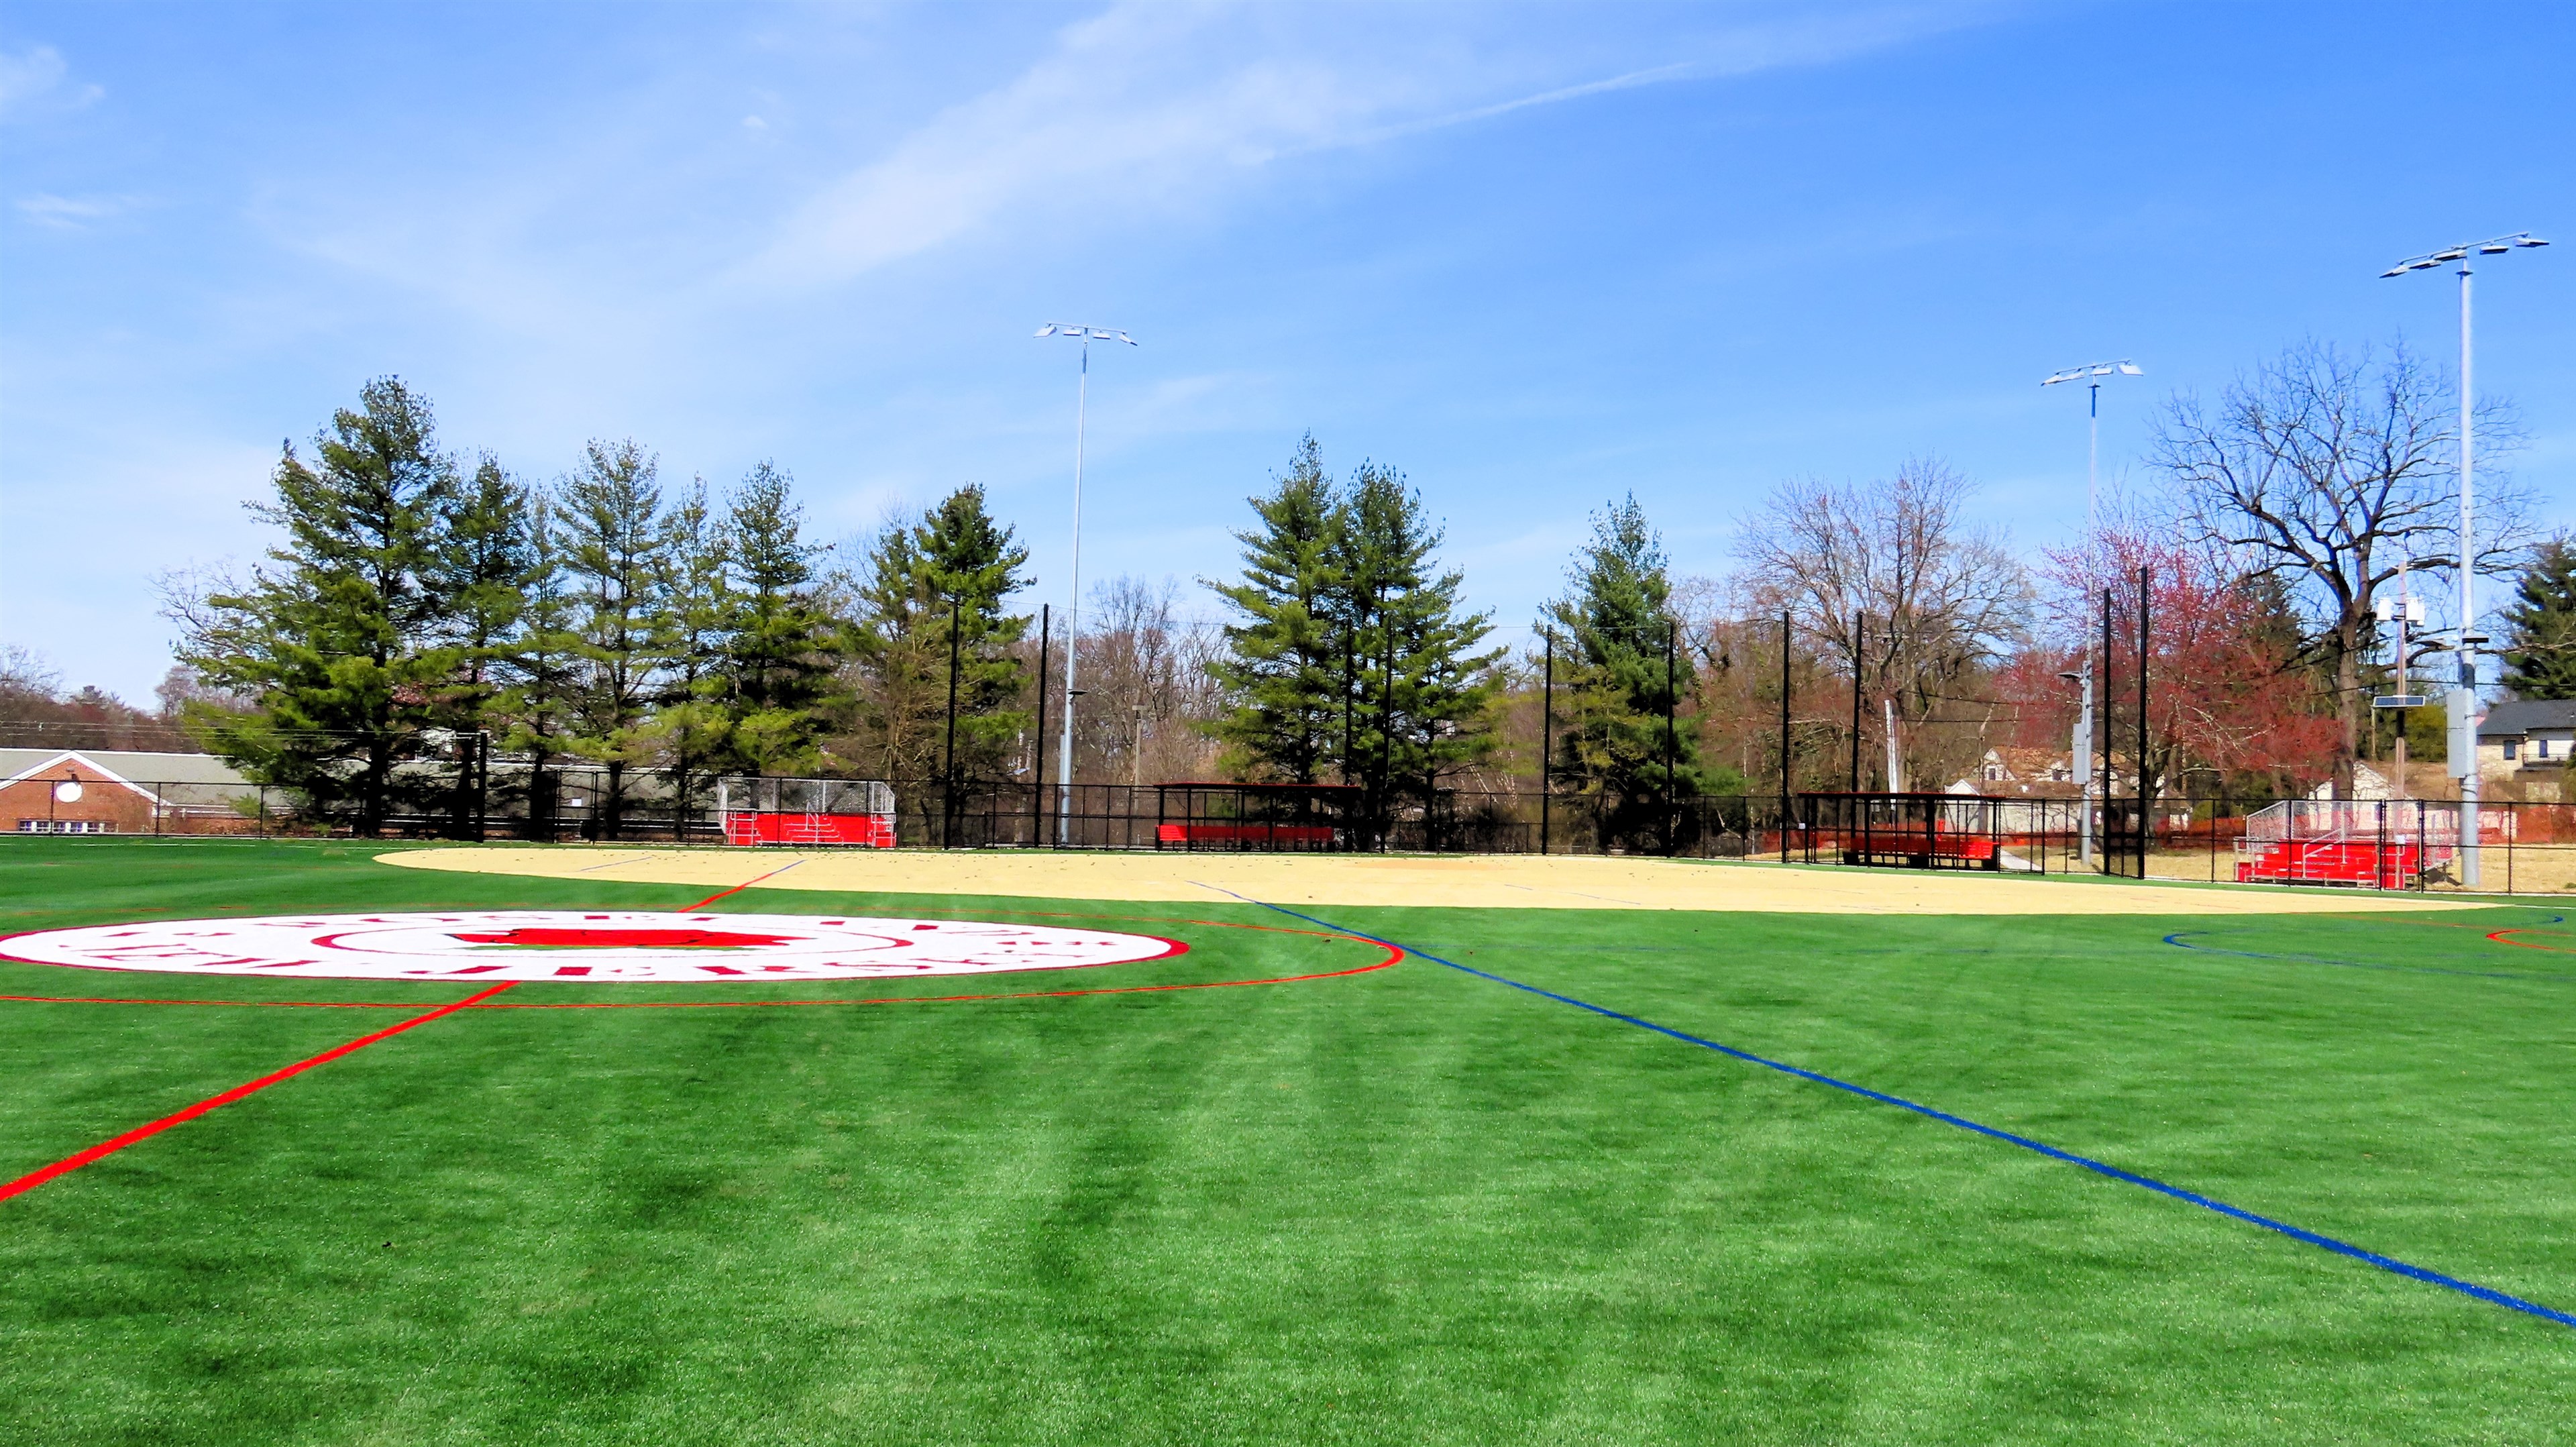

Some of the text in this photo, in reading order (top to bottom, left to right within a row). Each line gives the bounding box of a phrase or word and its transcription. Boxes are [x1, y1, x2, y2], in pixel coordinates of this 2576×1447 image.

[252, 915, 1034, 936] ROSELAND
[58, 943, 1093, 976] NEW JERSEY
